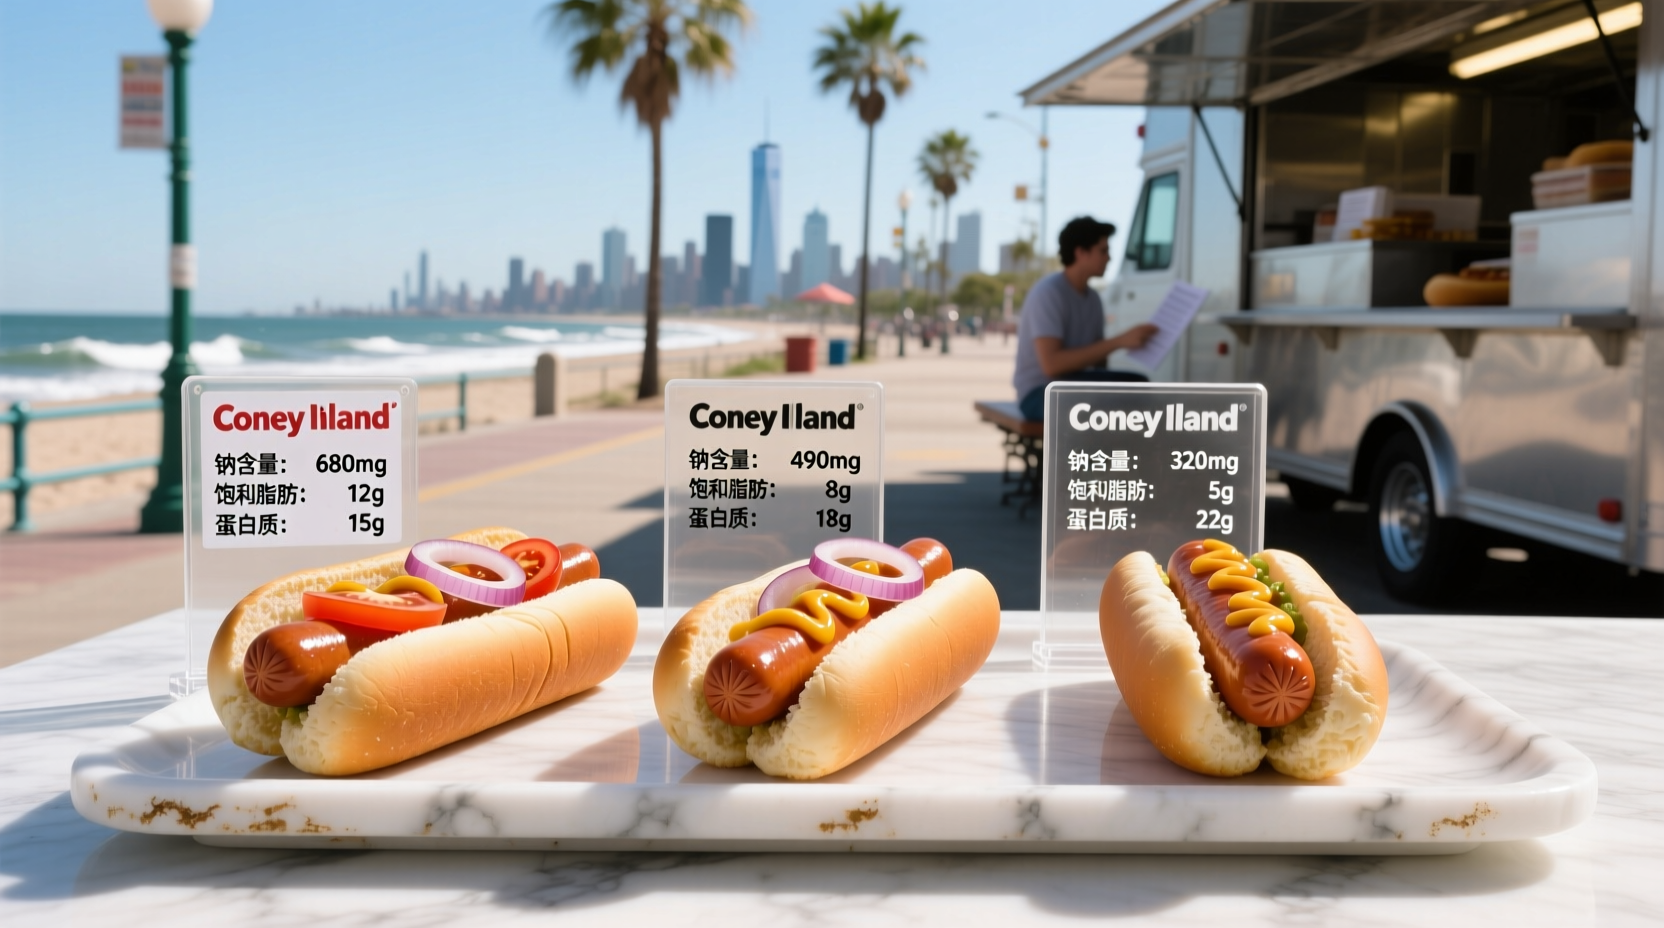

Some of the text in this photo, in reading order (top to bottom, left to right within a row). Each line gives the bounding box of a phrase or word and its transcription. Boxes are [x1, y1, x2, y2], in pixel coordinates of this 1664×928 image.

[213, 404, 304, 437] Coney
[689, 403, 778, 436] Coney
[1069, 402, 1163, 438] Coney
[215, 452, 386, 478] 钠含量： 680mg
[689, 448, 860, 475] 钠含量： 490mg
[1068, 449, 1239, 475] 钠含量： 320mg
[348, 484, 384, 507] 12g
[689, 478, 851, 503] 饱和脂肪： 8g
[1209, 481, 1233, 505] 5g
[216, 513, 384, 537] 蛋白质： 15g
[689, 507, 851, 532] 蛋白质： 18g
[1067, 507, 1233, 535] 蛋白质： 22g
